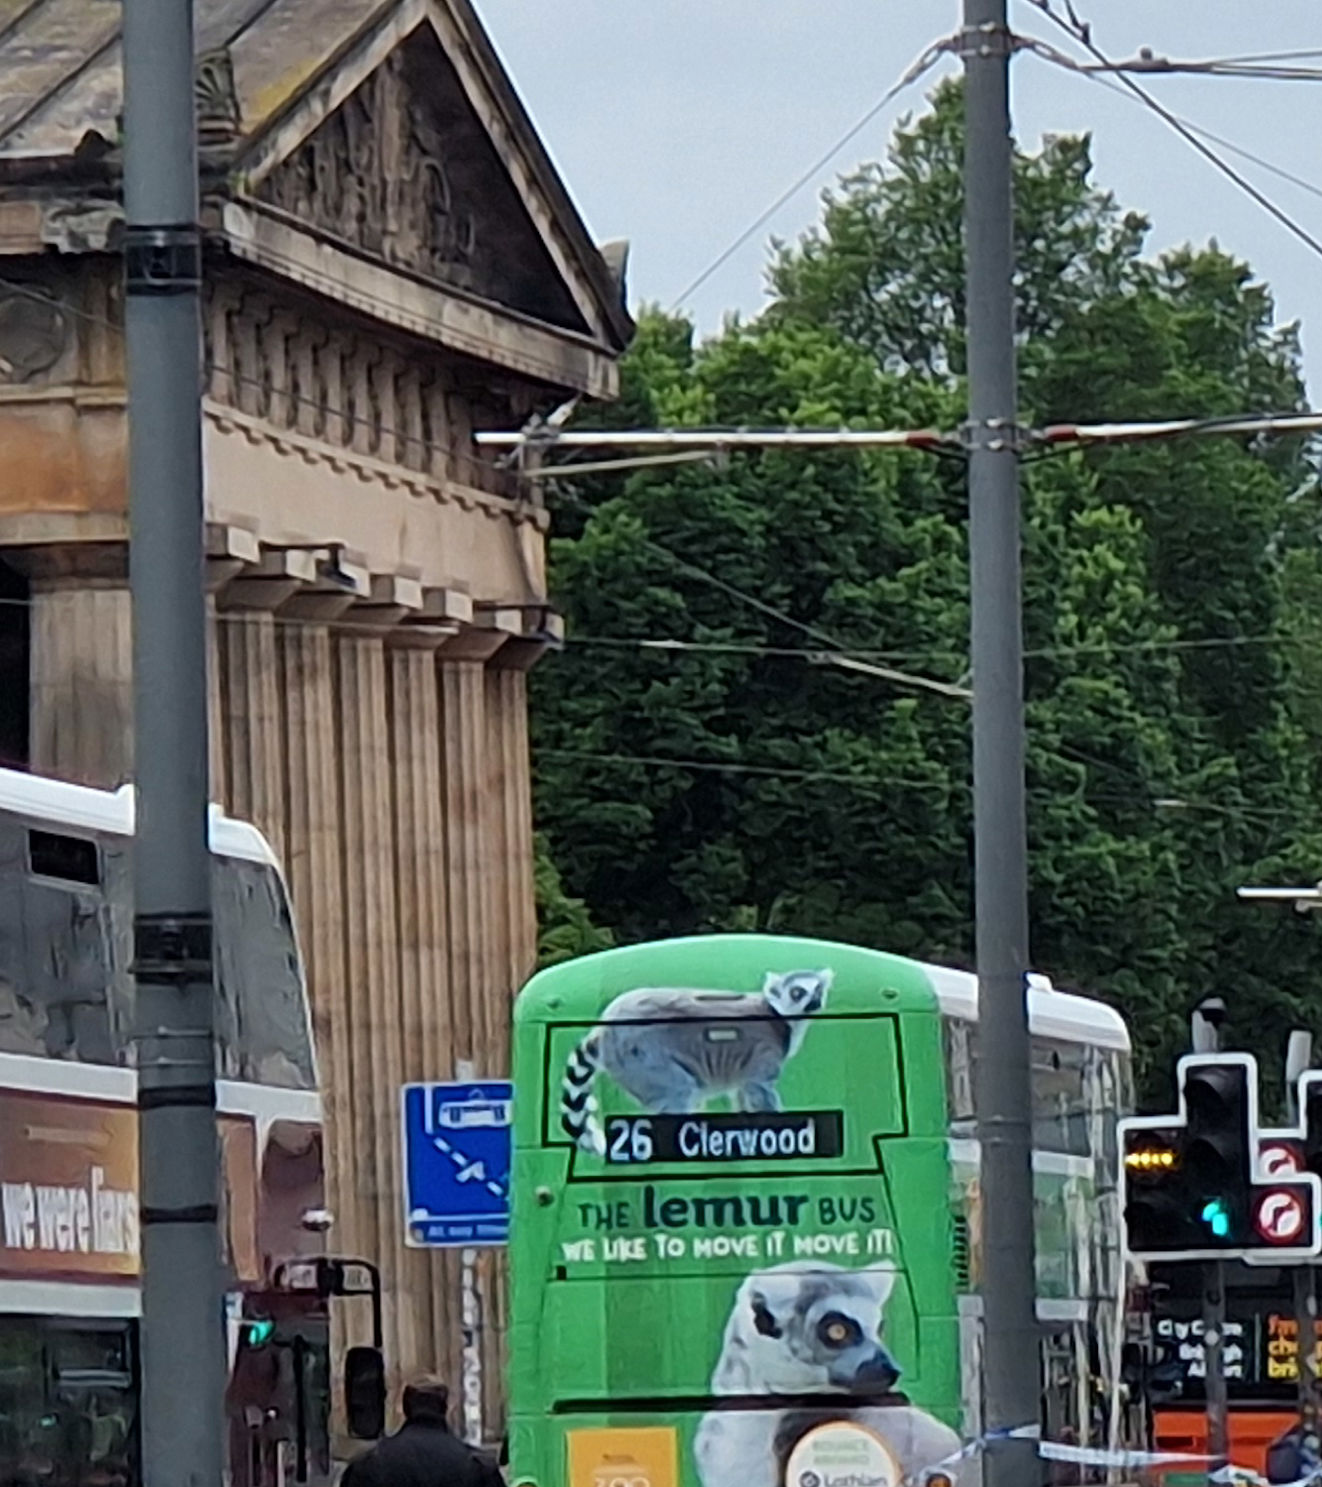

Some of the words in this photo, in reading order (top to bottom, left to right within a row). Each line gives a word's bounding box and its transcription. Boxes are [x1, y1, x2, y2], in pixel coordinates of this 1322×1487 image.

[609, 1118, 653, 1162] 26
[678, 1117, 816, 1158] Clerwood
[578, 1202, 630, 1231] THE
[643, 1185, 810, 1229] lemur
[818, 1196, 877, 1226] BUS
[561, 1239, 595, 1262] WE
[603, 1235, 647, 1261] LIKE
[655, 1233, 686, 1258] TO
[693, 1233, 760, 1258] MOVE
[766, 1230, 787, 1255] IT
[793, 1232, 860, 1256] MOVE
